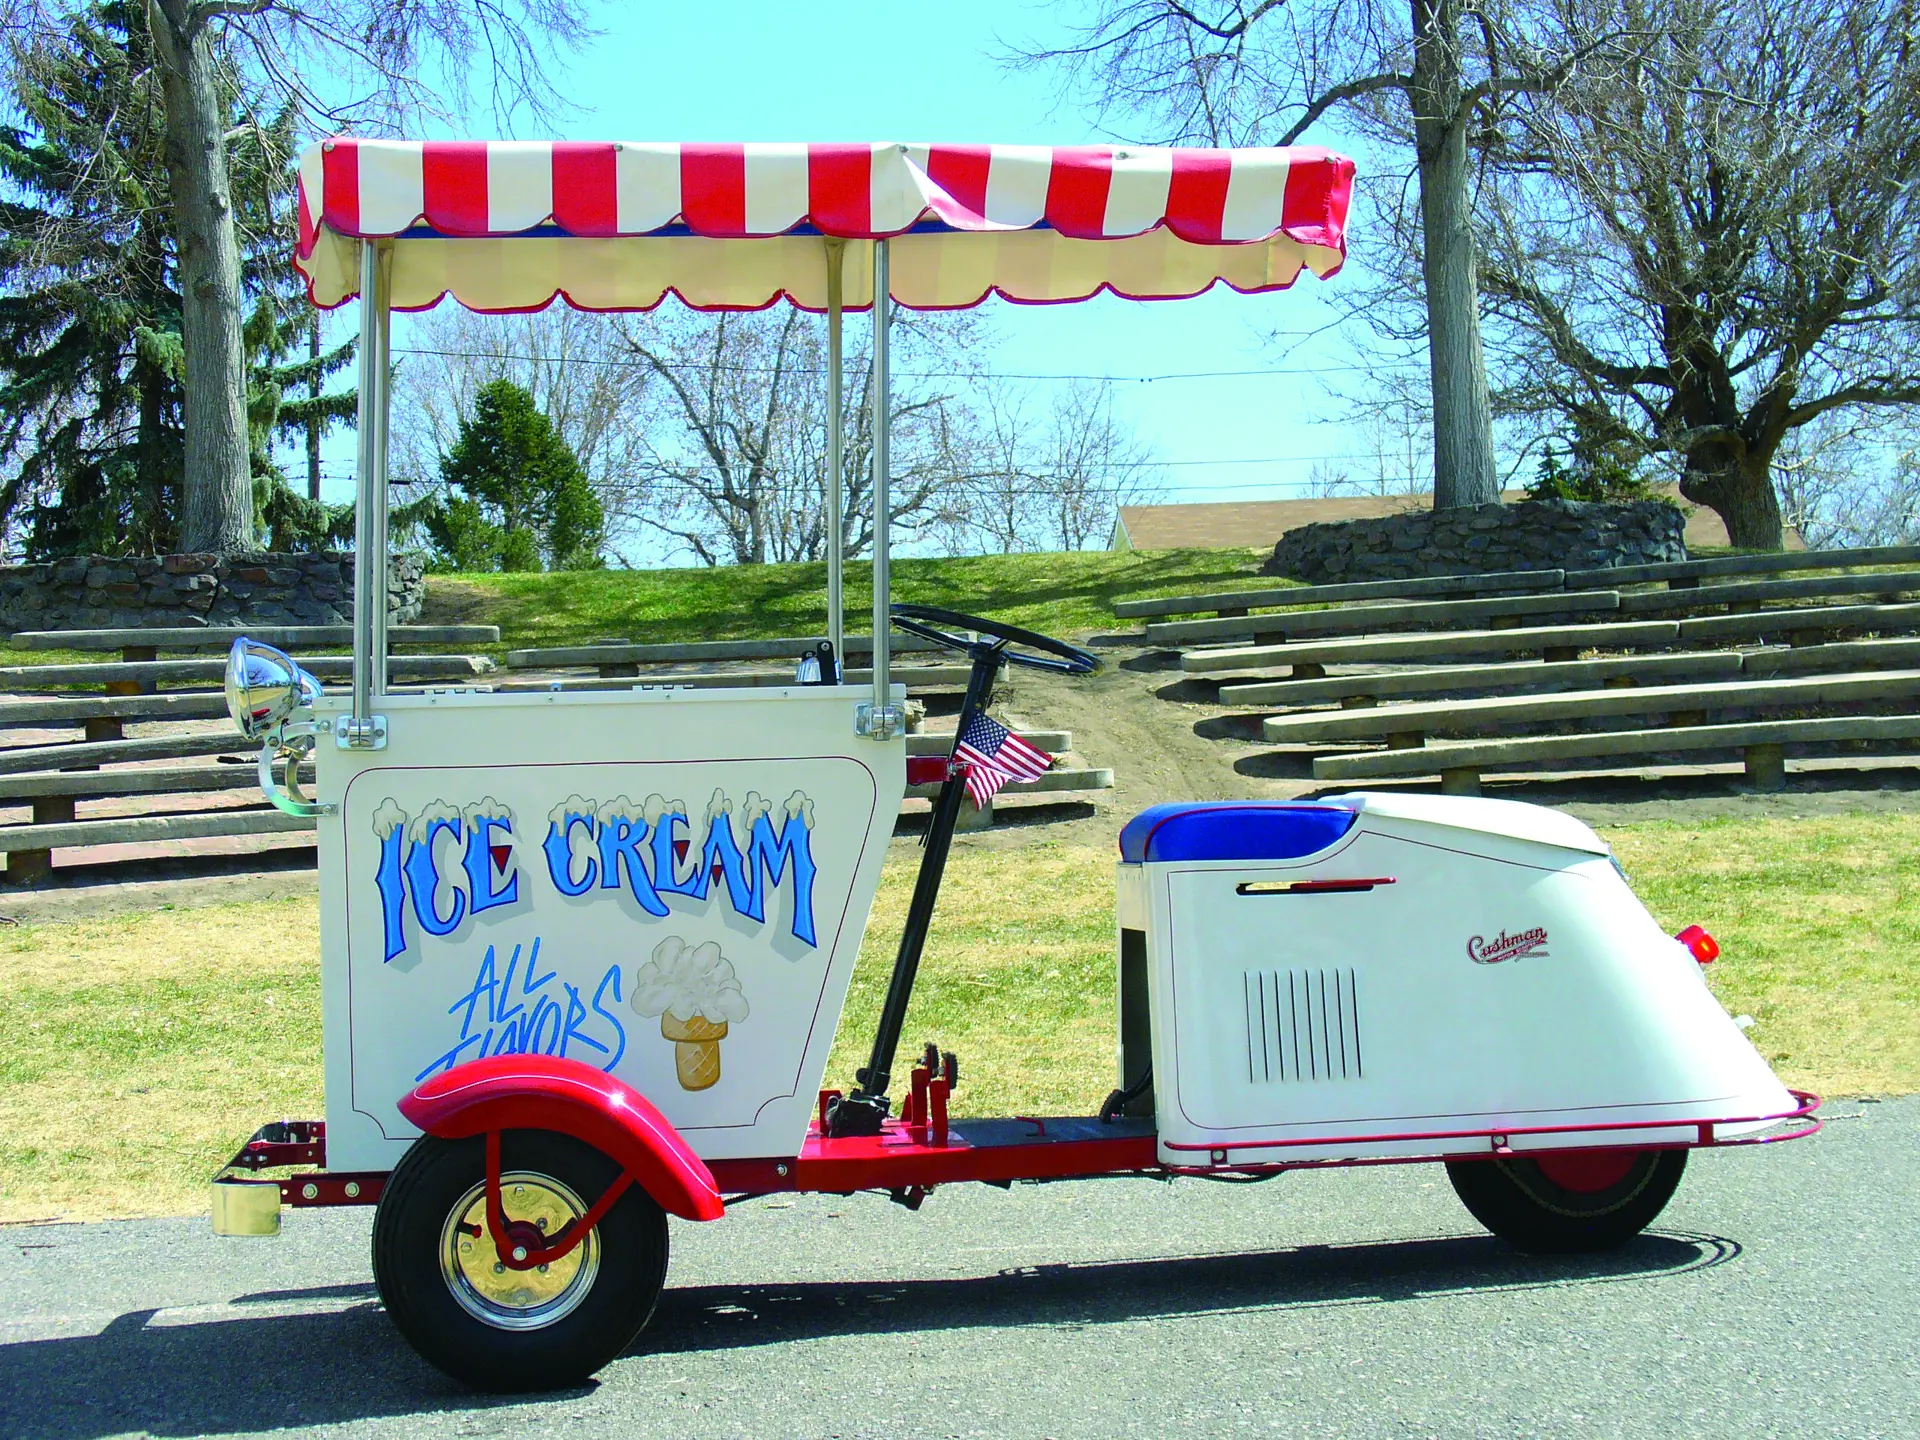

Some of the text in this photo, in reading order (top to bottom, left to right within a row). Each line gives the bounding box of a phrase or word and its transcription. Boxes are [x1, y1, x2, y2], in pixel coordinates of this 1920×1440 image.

[373, 788, 818, 964] ICE CREAM
[448, 936, 557, 1040] ALL
[1466, 926, 1547, 964] Cushman
